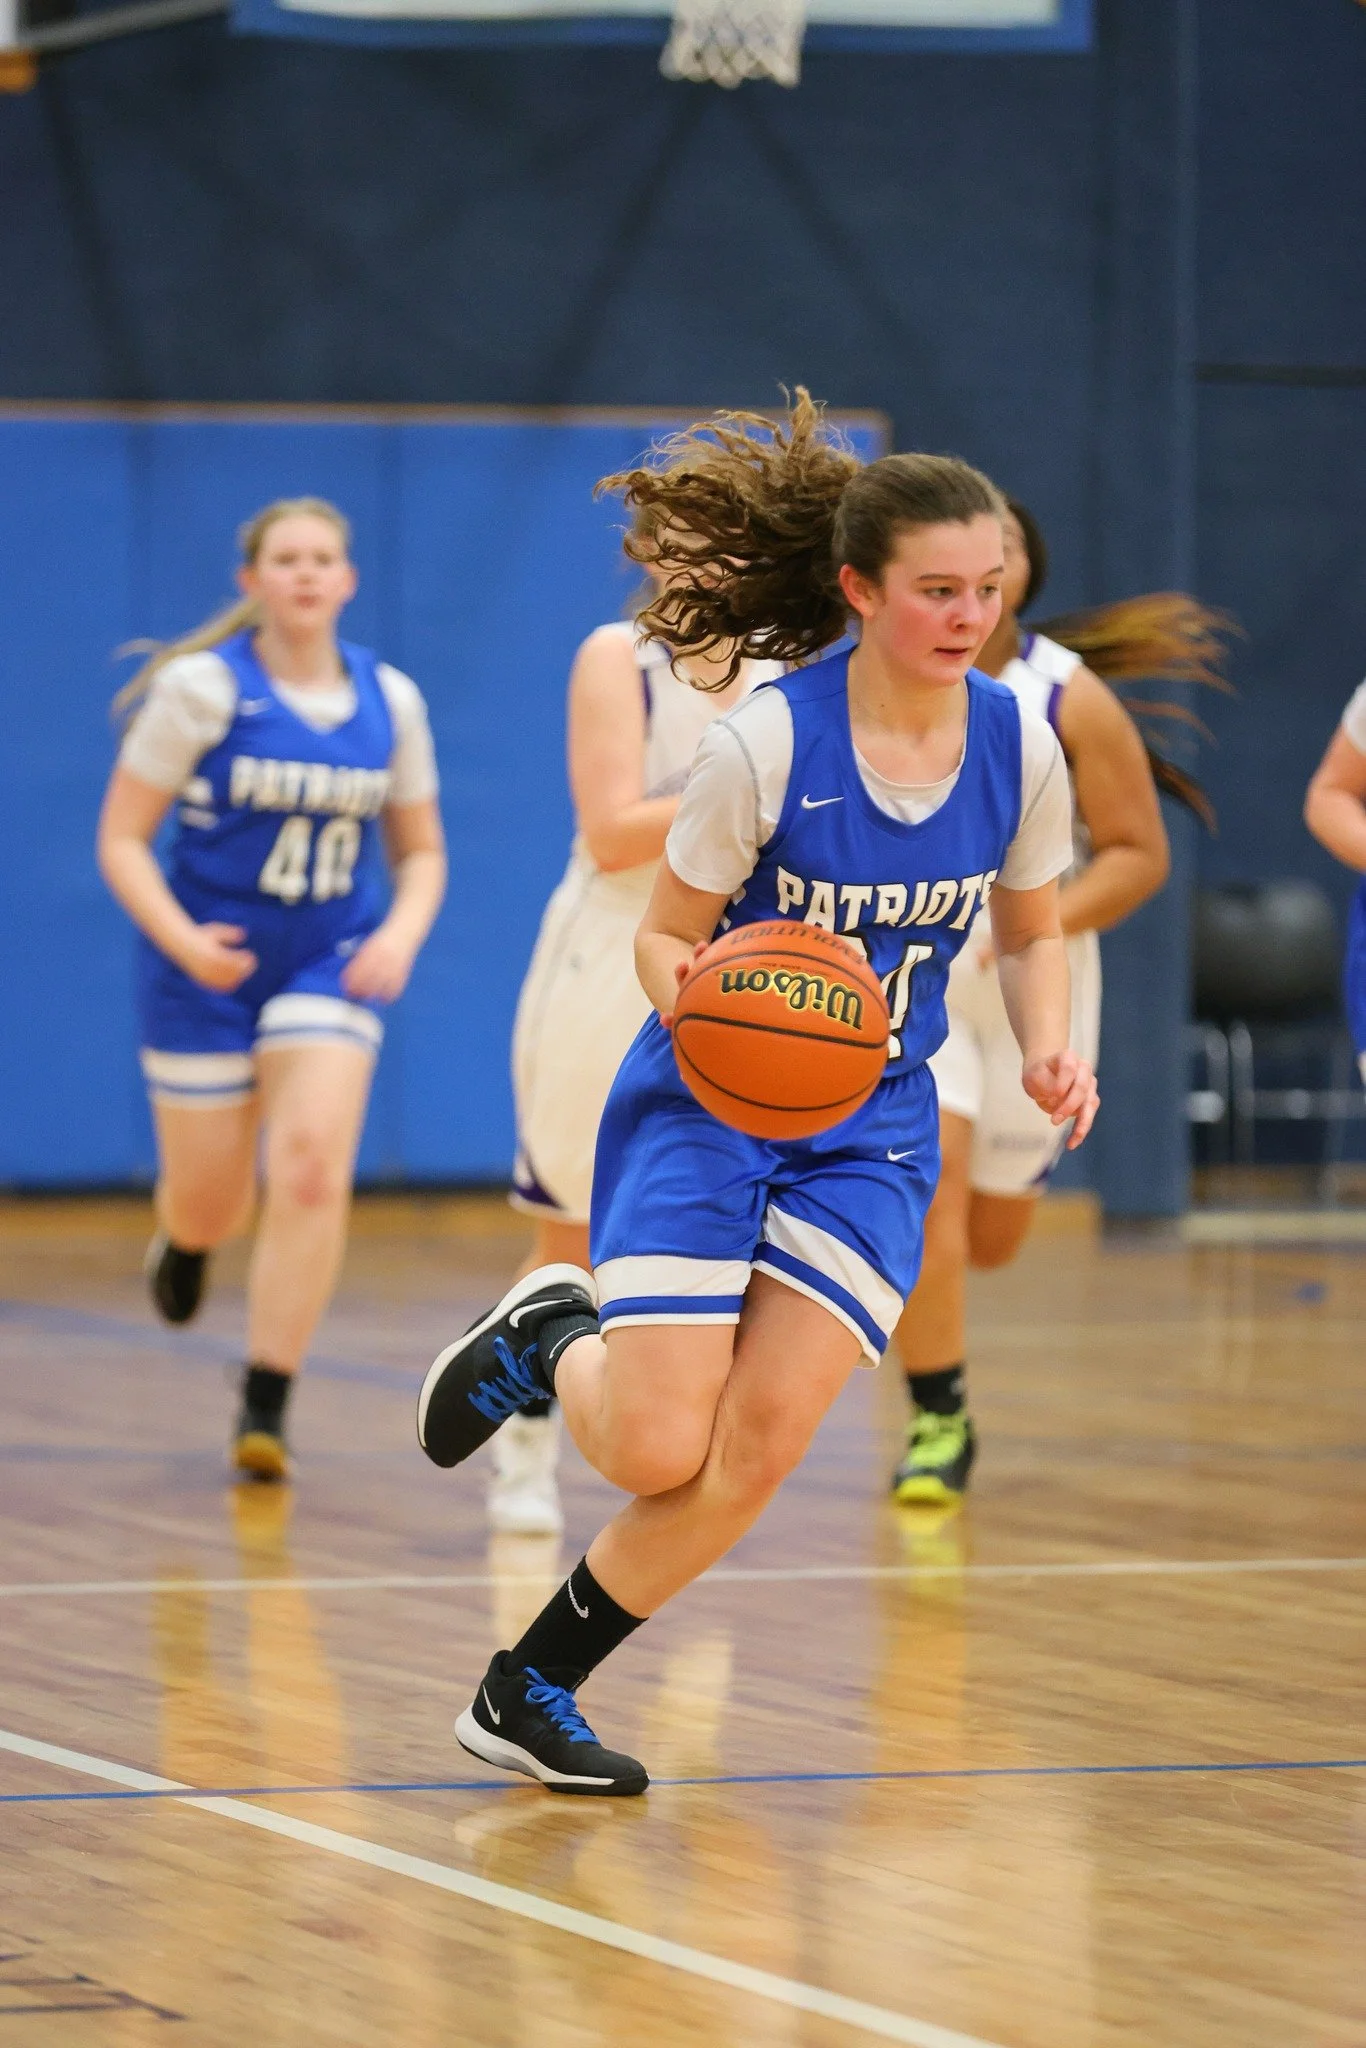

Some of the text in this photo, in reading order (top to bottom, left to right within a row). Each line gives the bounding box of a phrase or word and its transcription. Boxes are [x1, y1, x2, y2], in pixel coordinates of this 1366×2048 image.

[229, 755, 391, 819] PATRIOT
[257, 814, 362, 905] 40
[720, 967, 864, 1031] Wilson
